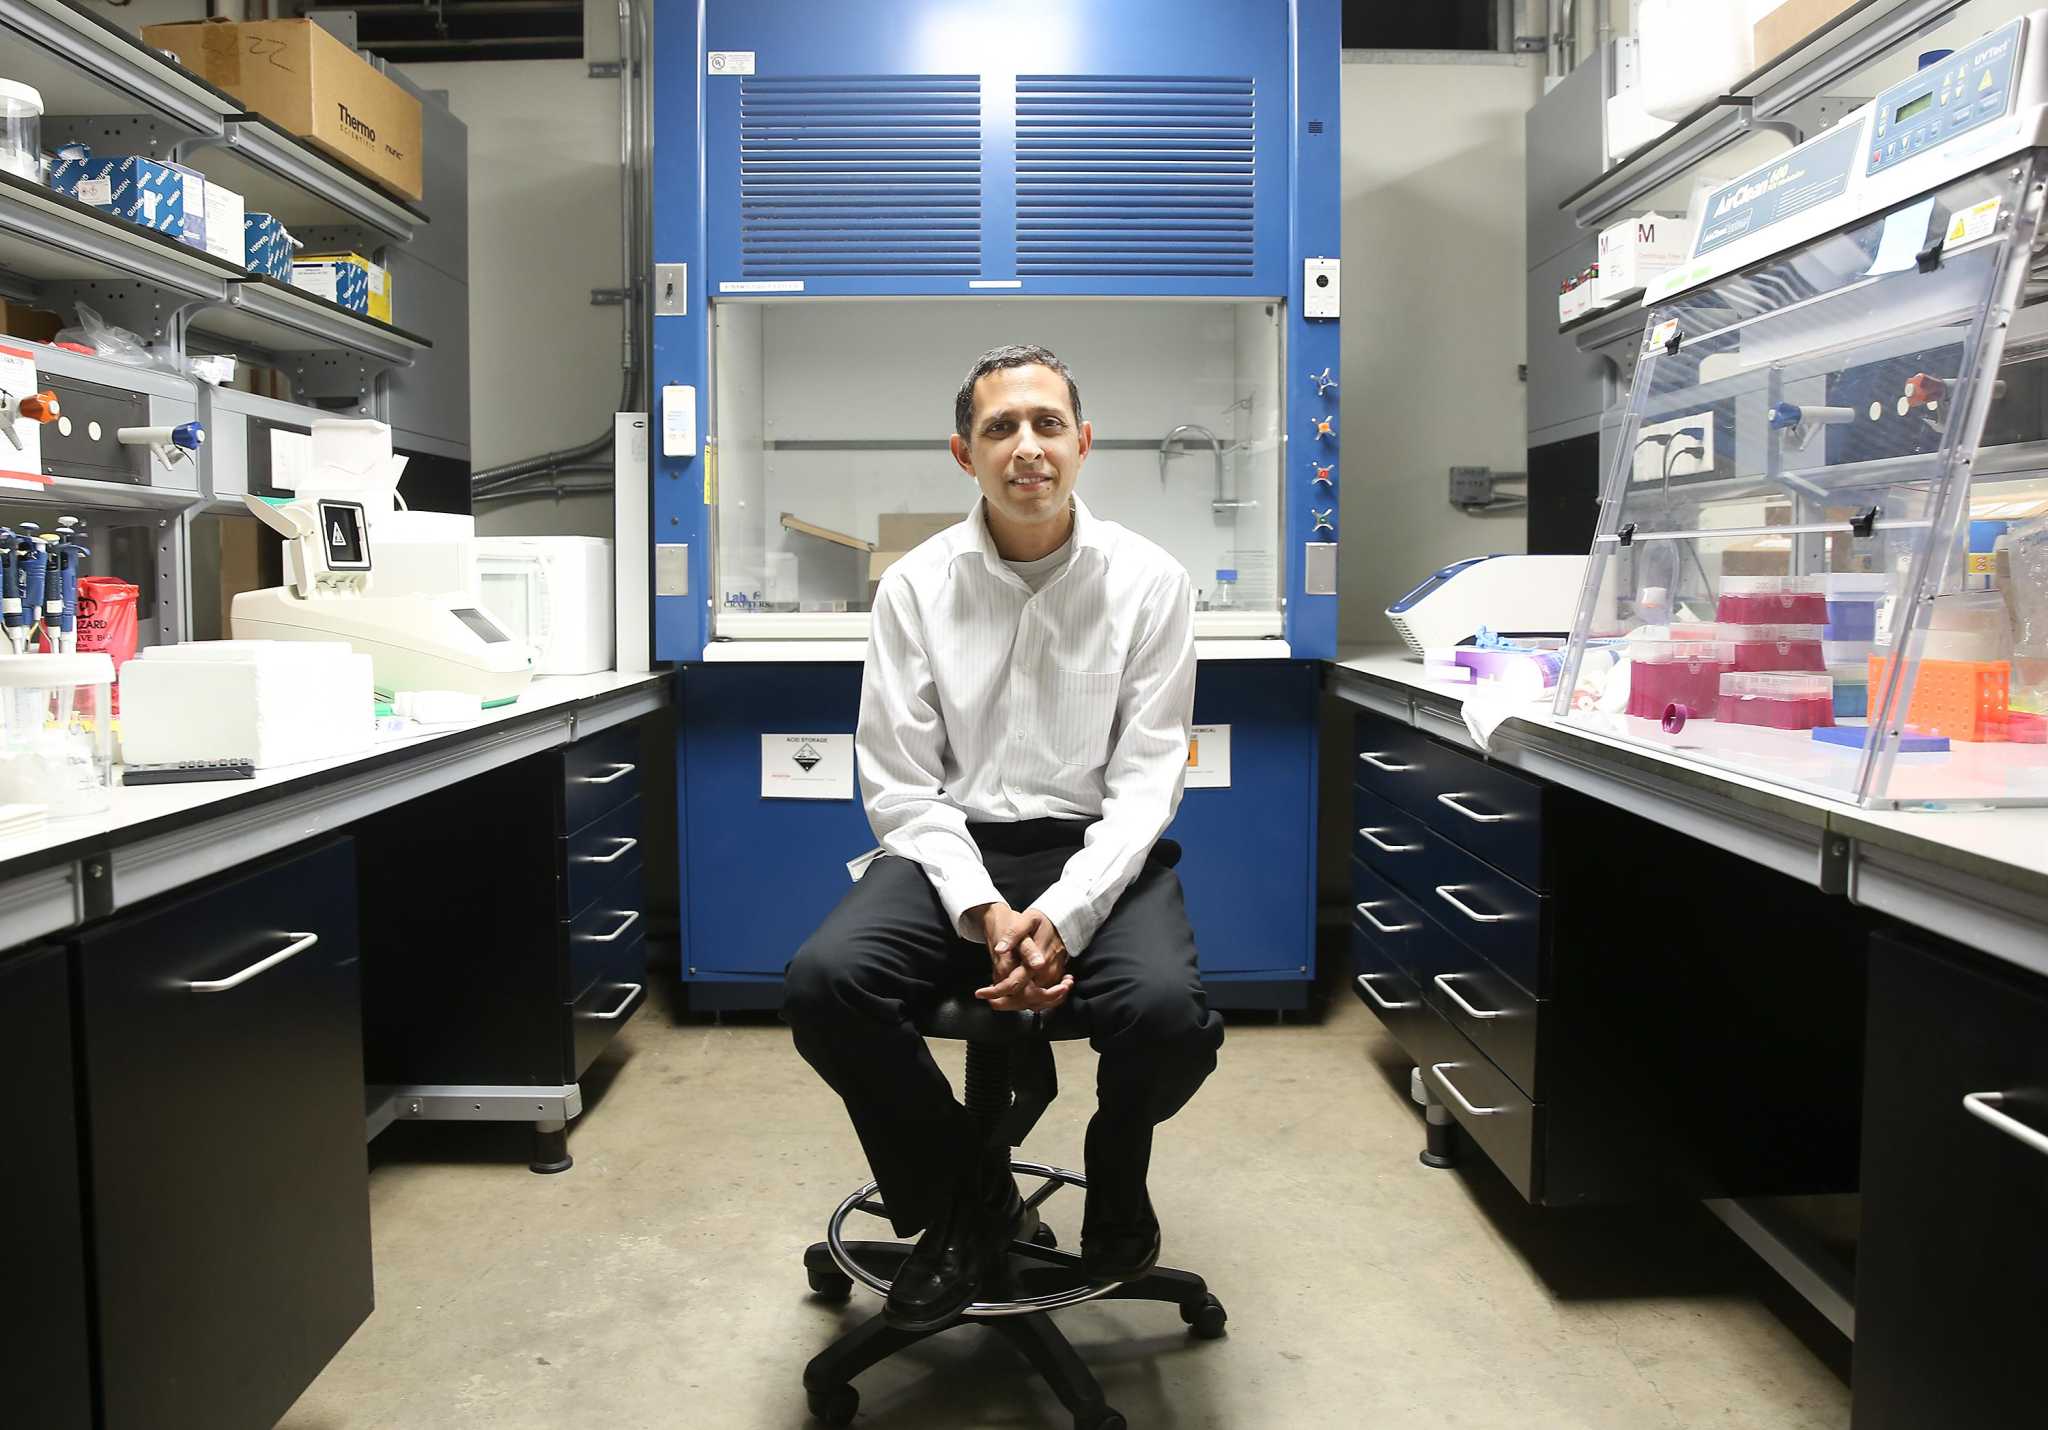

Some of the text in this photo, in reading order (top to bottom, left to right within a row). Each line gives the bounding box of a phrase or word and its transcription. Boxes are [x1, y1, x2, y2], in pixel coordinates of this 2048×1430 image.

[337, 103, 376, 142] Thermo
[112, 178, 132, 201] QIAGEN
[1713, 178, 1770, 218] AirClean
[1638, 223, 1655, 243] M
[249, 235, 269, 254] QIAGEN
[1600, 235, 1609, 257] M
[726, 591, 747, 604] Lab
